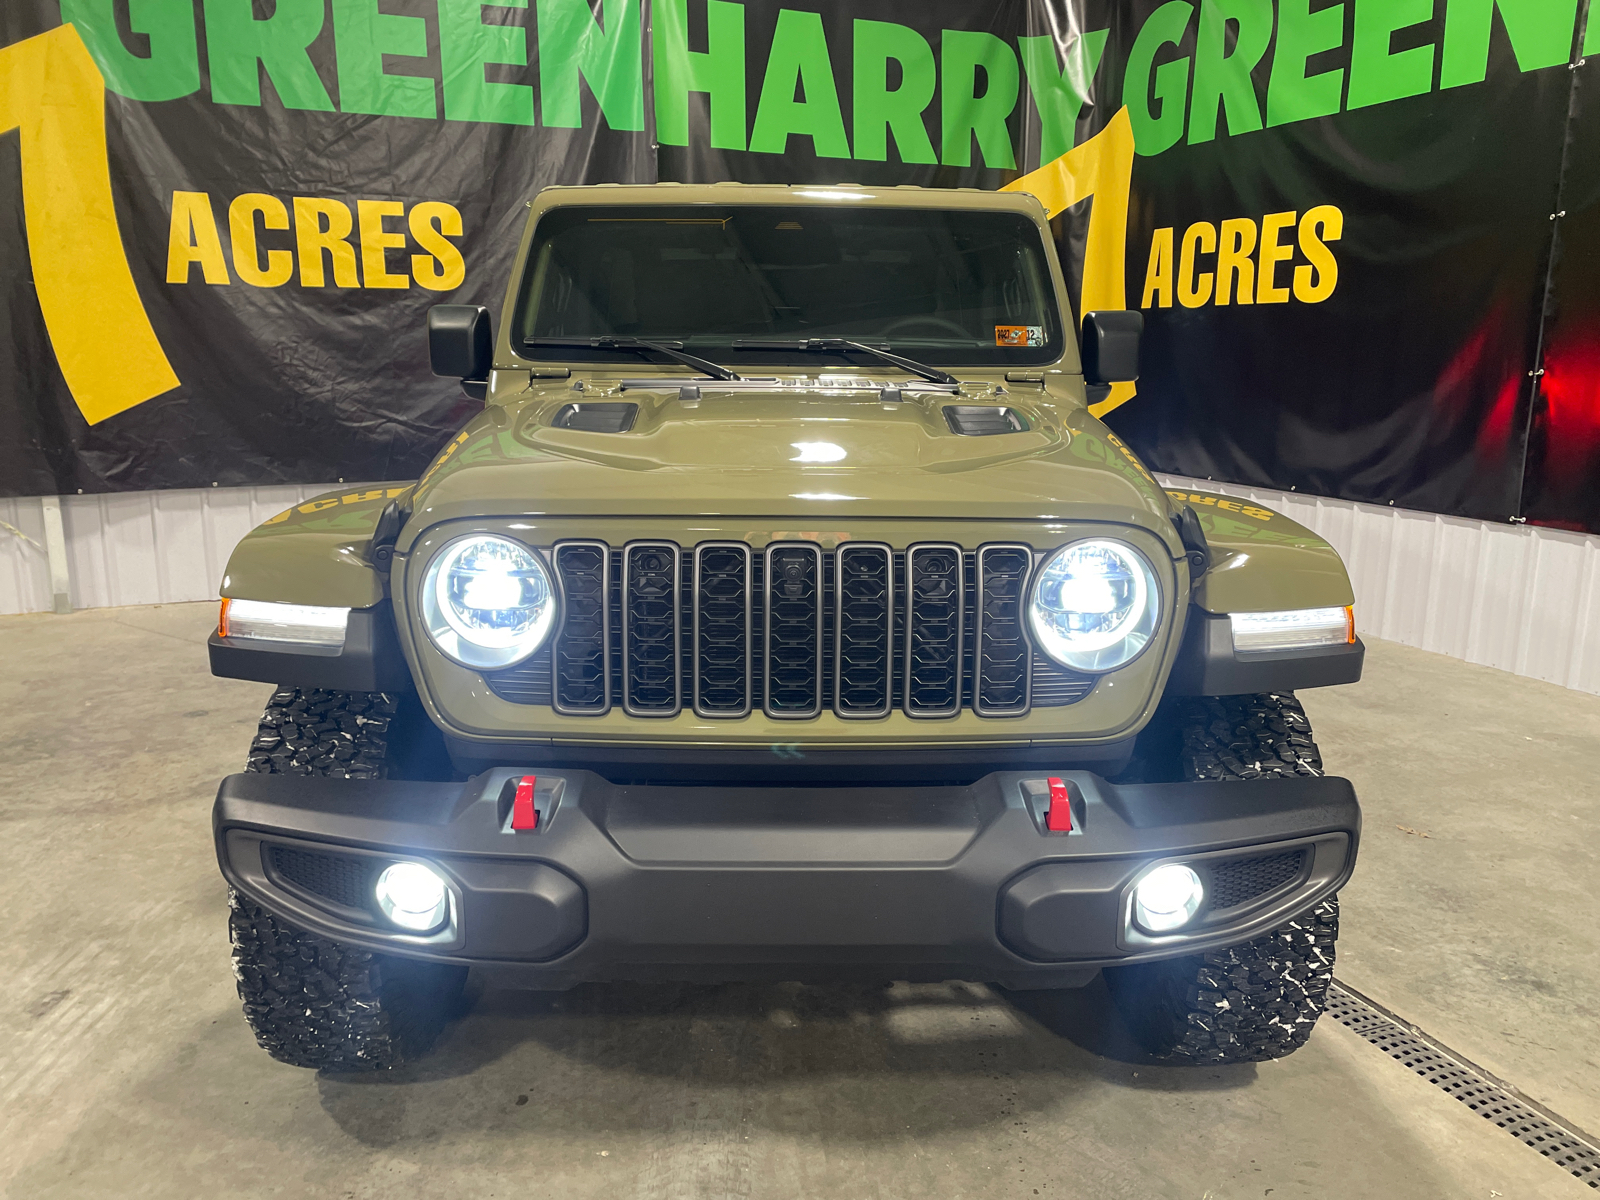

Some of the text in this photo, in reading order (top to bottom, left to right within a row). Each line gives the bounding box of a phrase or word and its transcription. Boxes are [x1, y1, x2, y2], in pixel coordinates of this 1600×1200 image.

[652, 0, 1110, 171] HARRY
[166, 190, 466, 291] ACRES
[1141, 204, 1343, 309] ACRES
